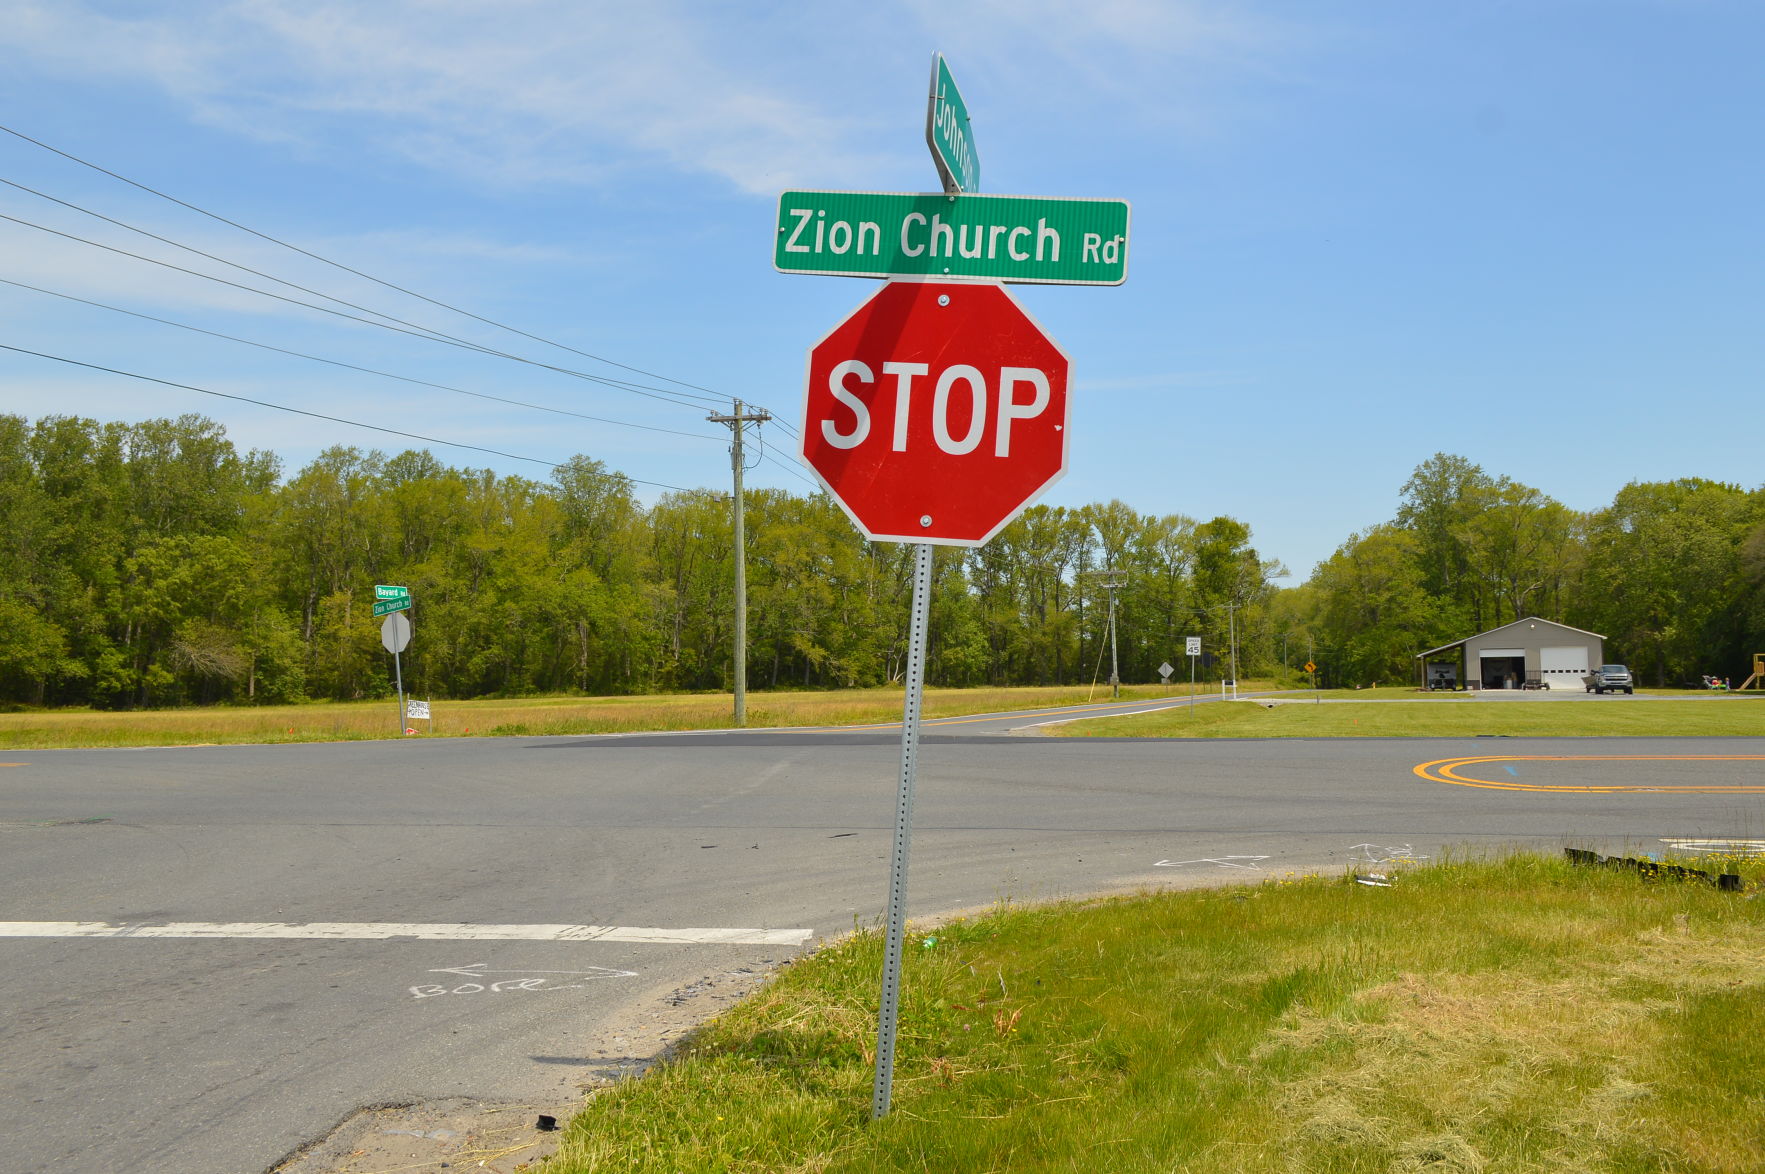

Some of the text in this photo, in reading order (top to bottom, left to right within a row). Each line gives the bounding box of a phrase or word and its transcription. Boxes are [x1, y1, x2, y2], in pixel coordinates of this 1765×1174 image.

[785, 208, 1120, 264] Zion Church Rd
[821, 359, 1051, 458] STOP
[375, 605, 385, 614] Zion
[387, 600, 403, 610] Church
[378, 588, 398, 597] Bayard
